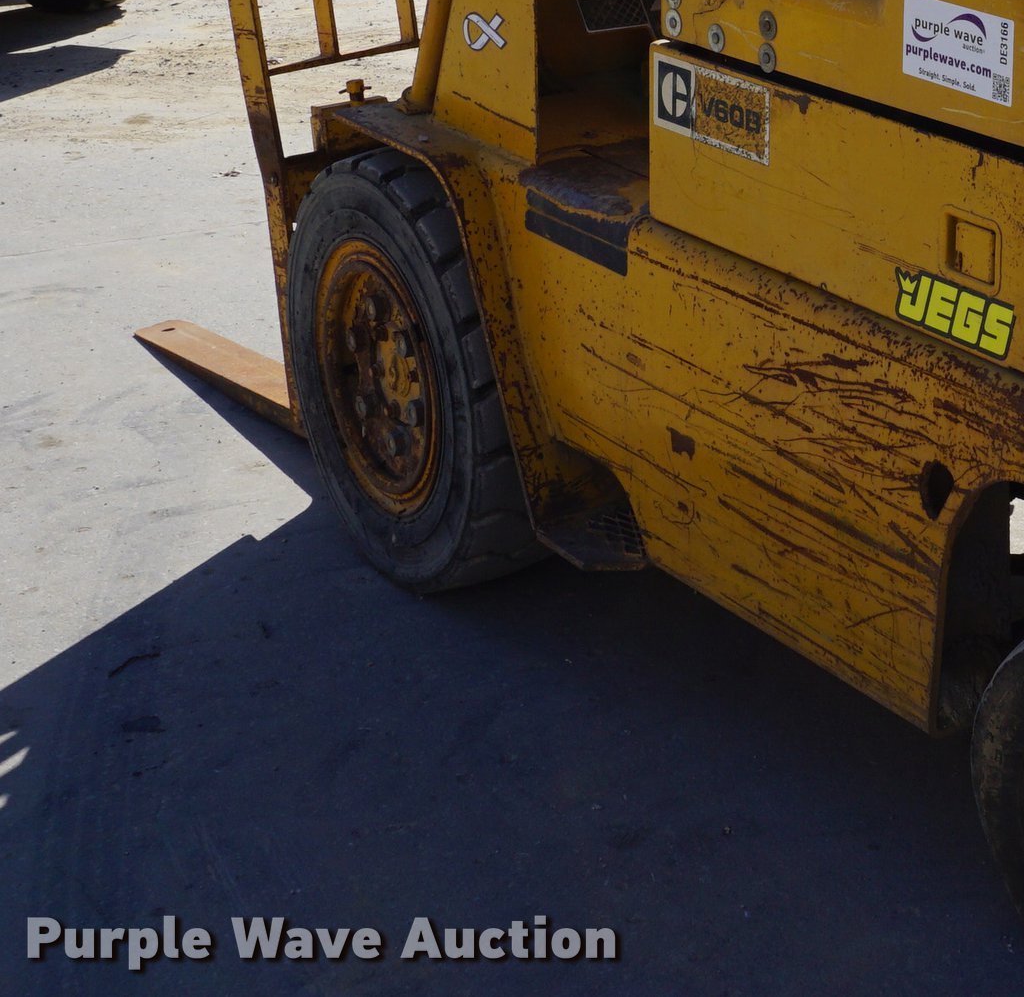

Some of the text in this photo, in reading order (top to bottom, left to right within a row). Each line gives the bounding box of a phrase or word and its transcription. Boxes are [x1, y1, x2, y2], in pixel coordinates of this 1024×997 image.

[914, 18, 984, 46] purple wave
[962, 43, 984, 54] auction
[1000, 21, 1009, 66] DE3166
[905, 43, 992, 78] purplewave.com
[918, 67, 977, 92] Straight. Simple. Sold.
[701, 97, 761, 134] V60B
[897, 270, 1014, 358] JEGS
